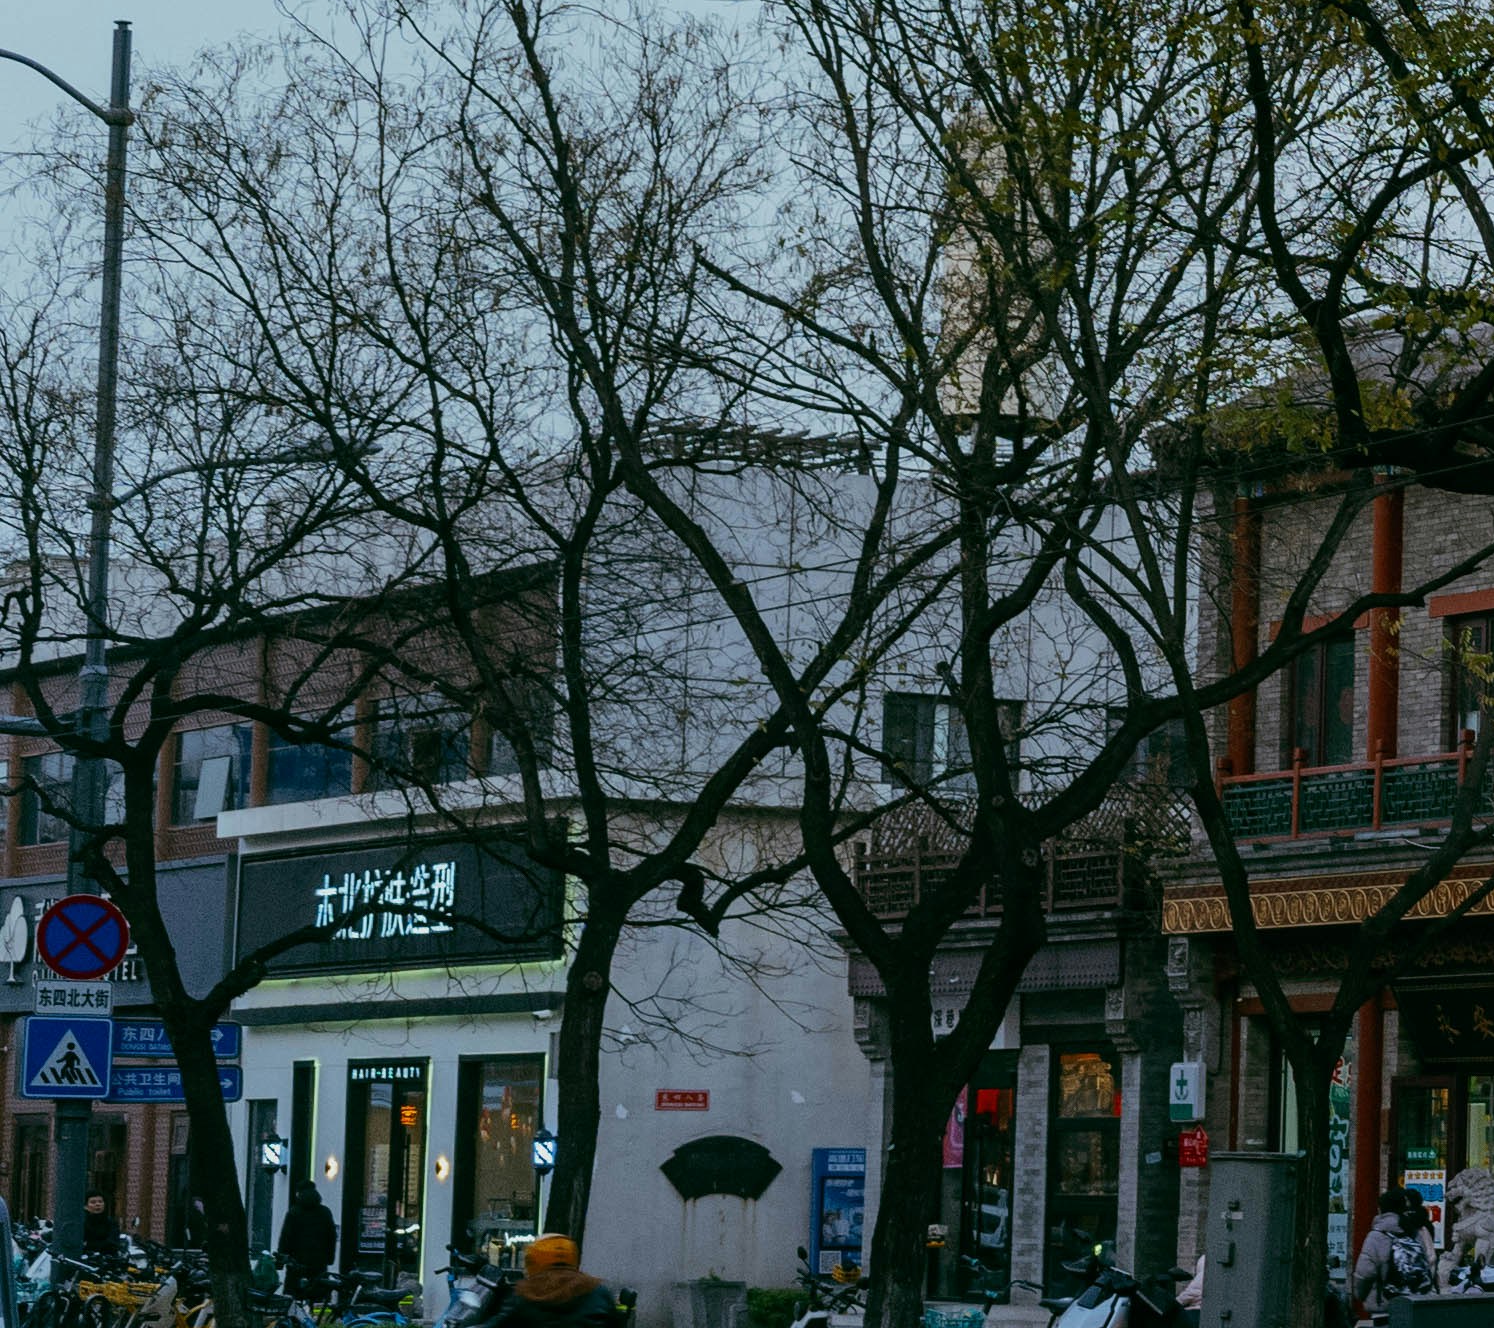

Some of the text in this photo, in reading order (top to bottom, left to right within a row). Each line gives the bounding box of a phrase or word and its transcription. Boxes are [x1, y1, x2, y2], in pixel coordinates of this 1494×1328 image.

[39, 987, 109, 1008] 东四北大街
[117, 1088, 172, 1097] Public toilet
